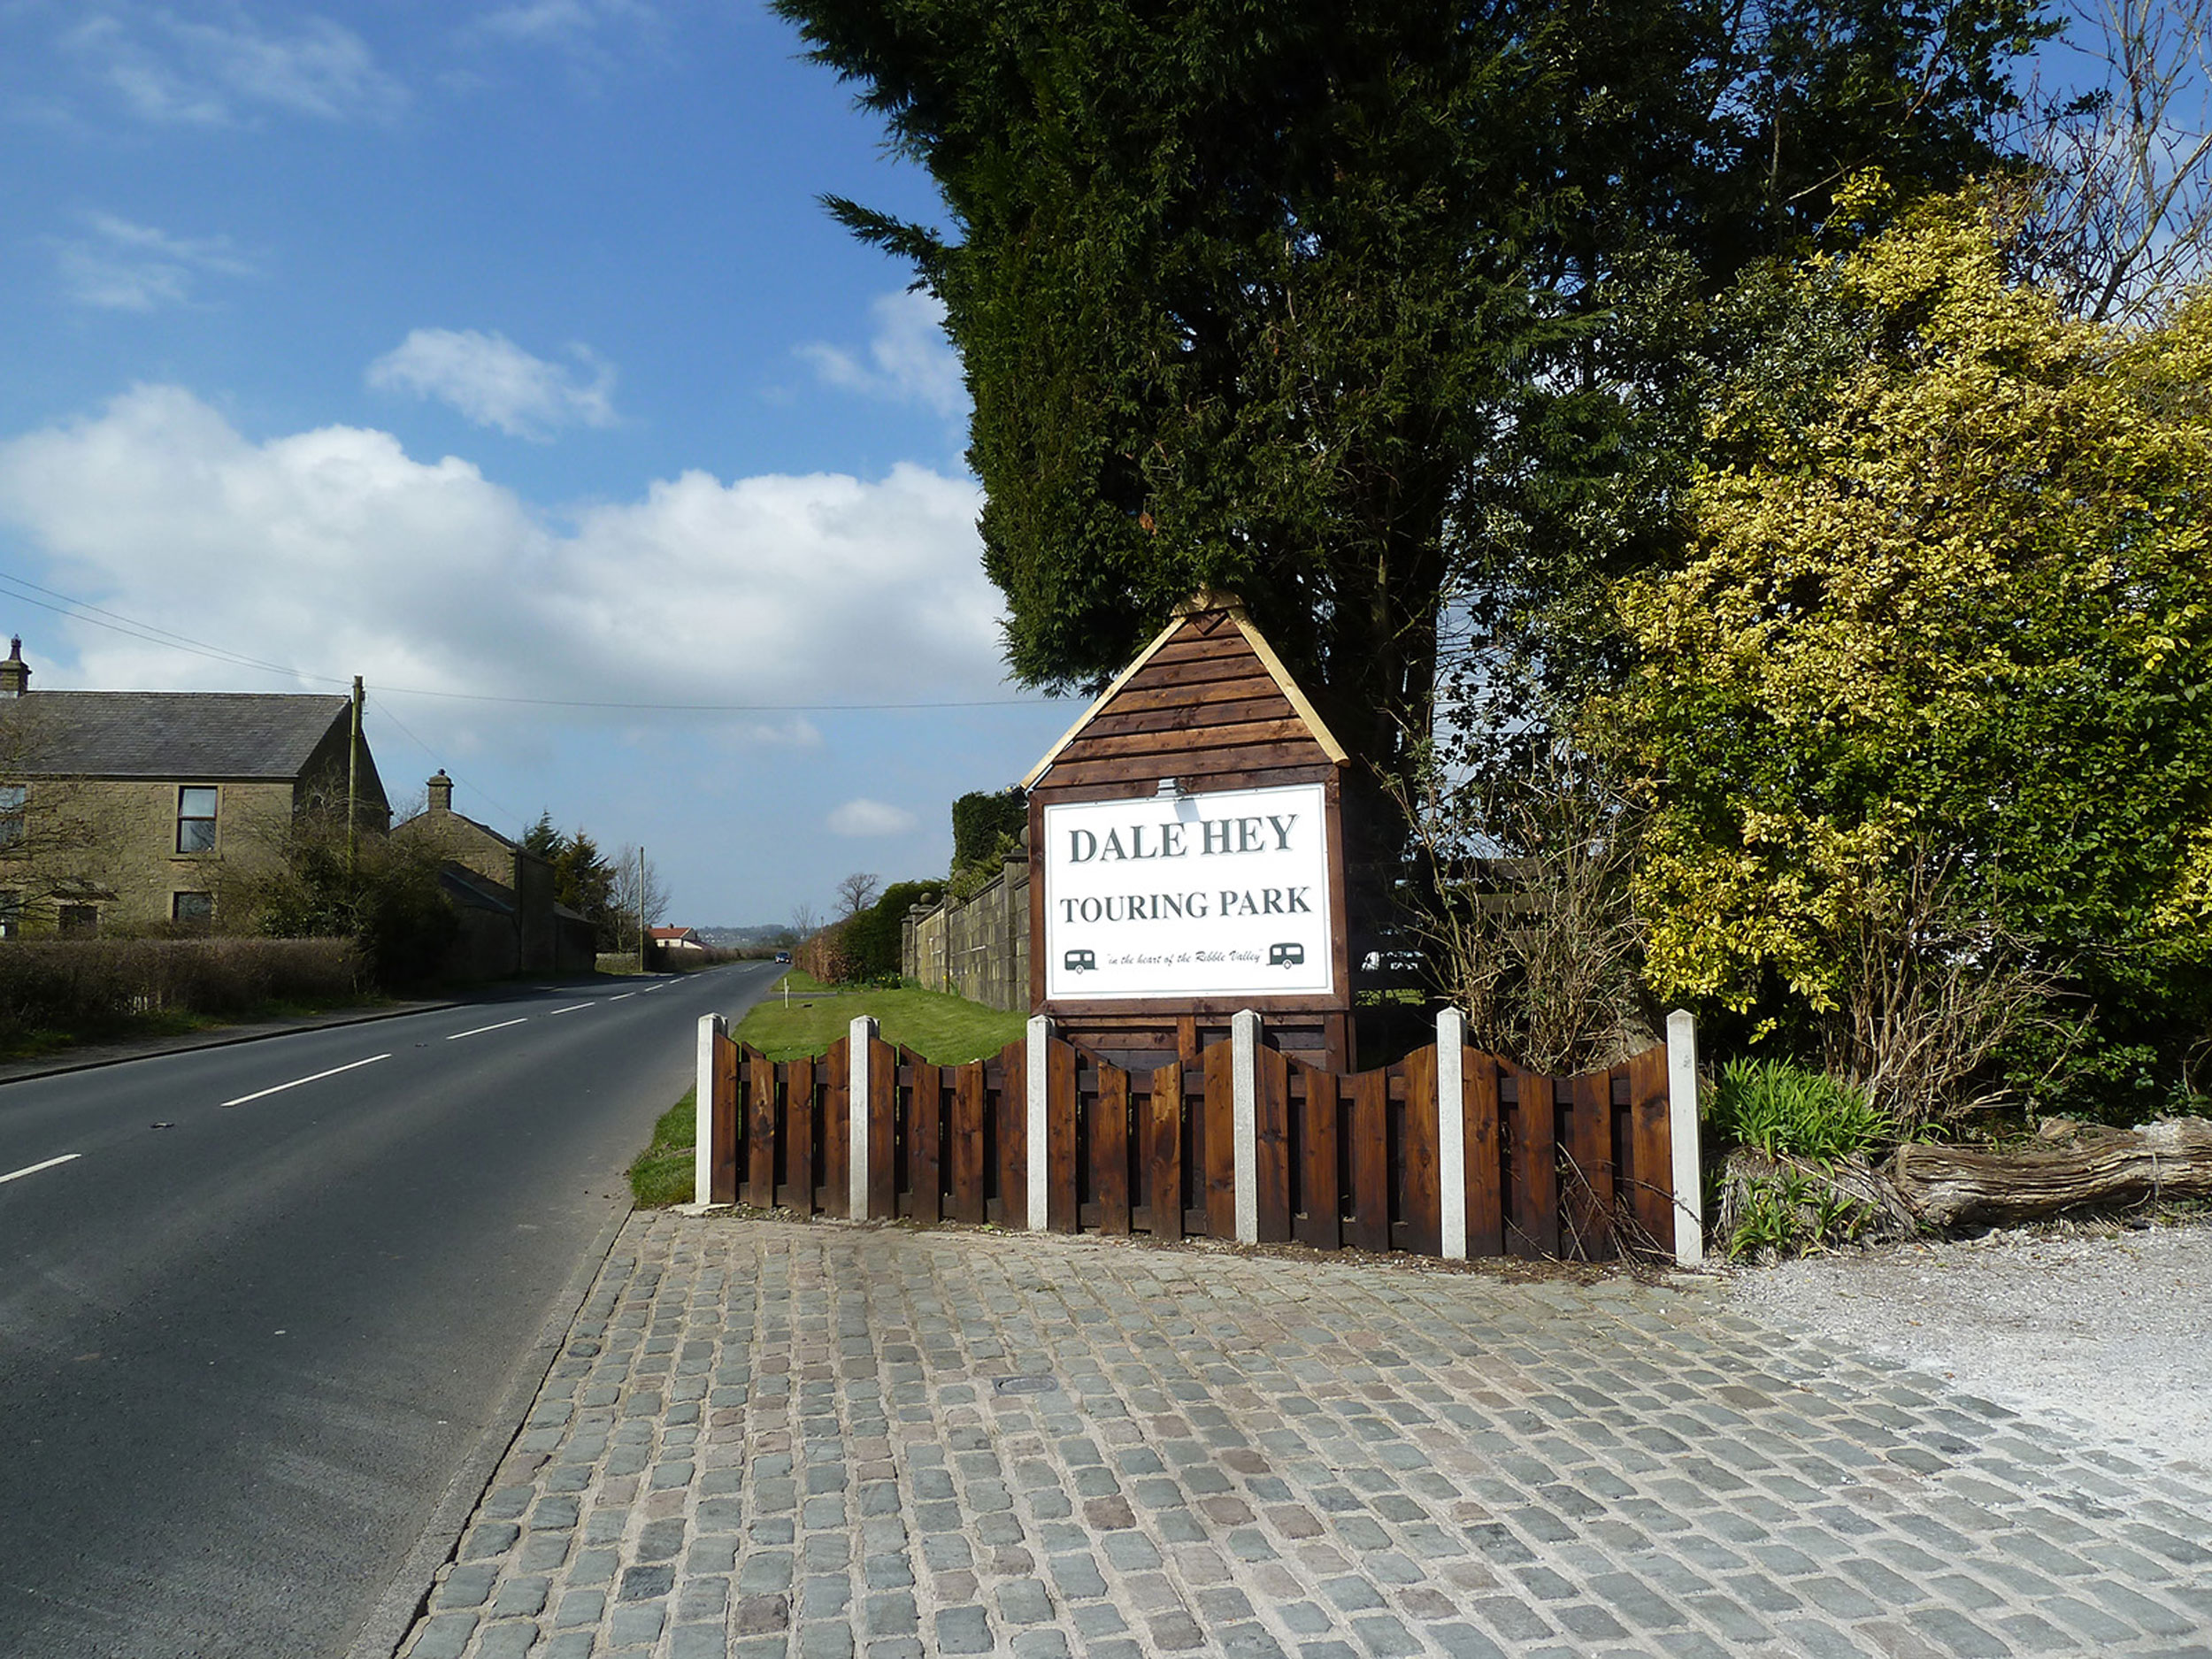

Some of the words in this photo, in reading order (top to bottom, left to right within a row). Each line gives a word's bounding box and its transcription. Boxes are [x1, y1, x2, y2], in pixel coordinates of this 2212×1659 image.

[1069, 822, 1187, 864] DALE
[1199, 813, 1297, 855] HEY
[1059, 892, 1209, 923] TOURING
[1219, 887, 1311, 917] PARK
[1120, 954, 1134, 964] the
[1137, 954, 1162, 964] heart
[1164, 954, 1174, 966] of
[1177, 952, 1191, 964] the
[1195, 950, 1226, 963] Ribble
